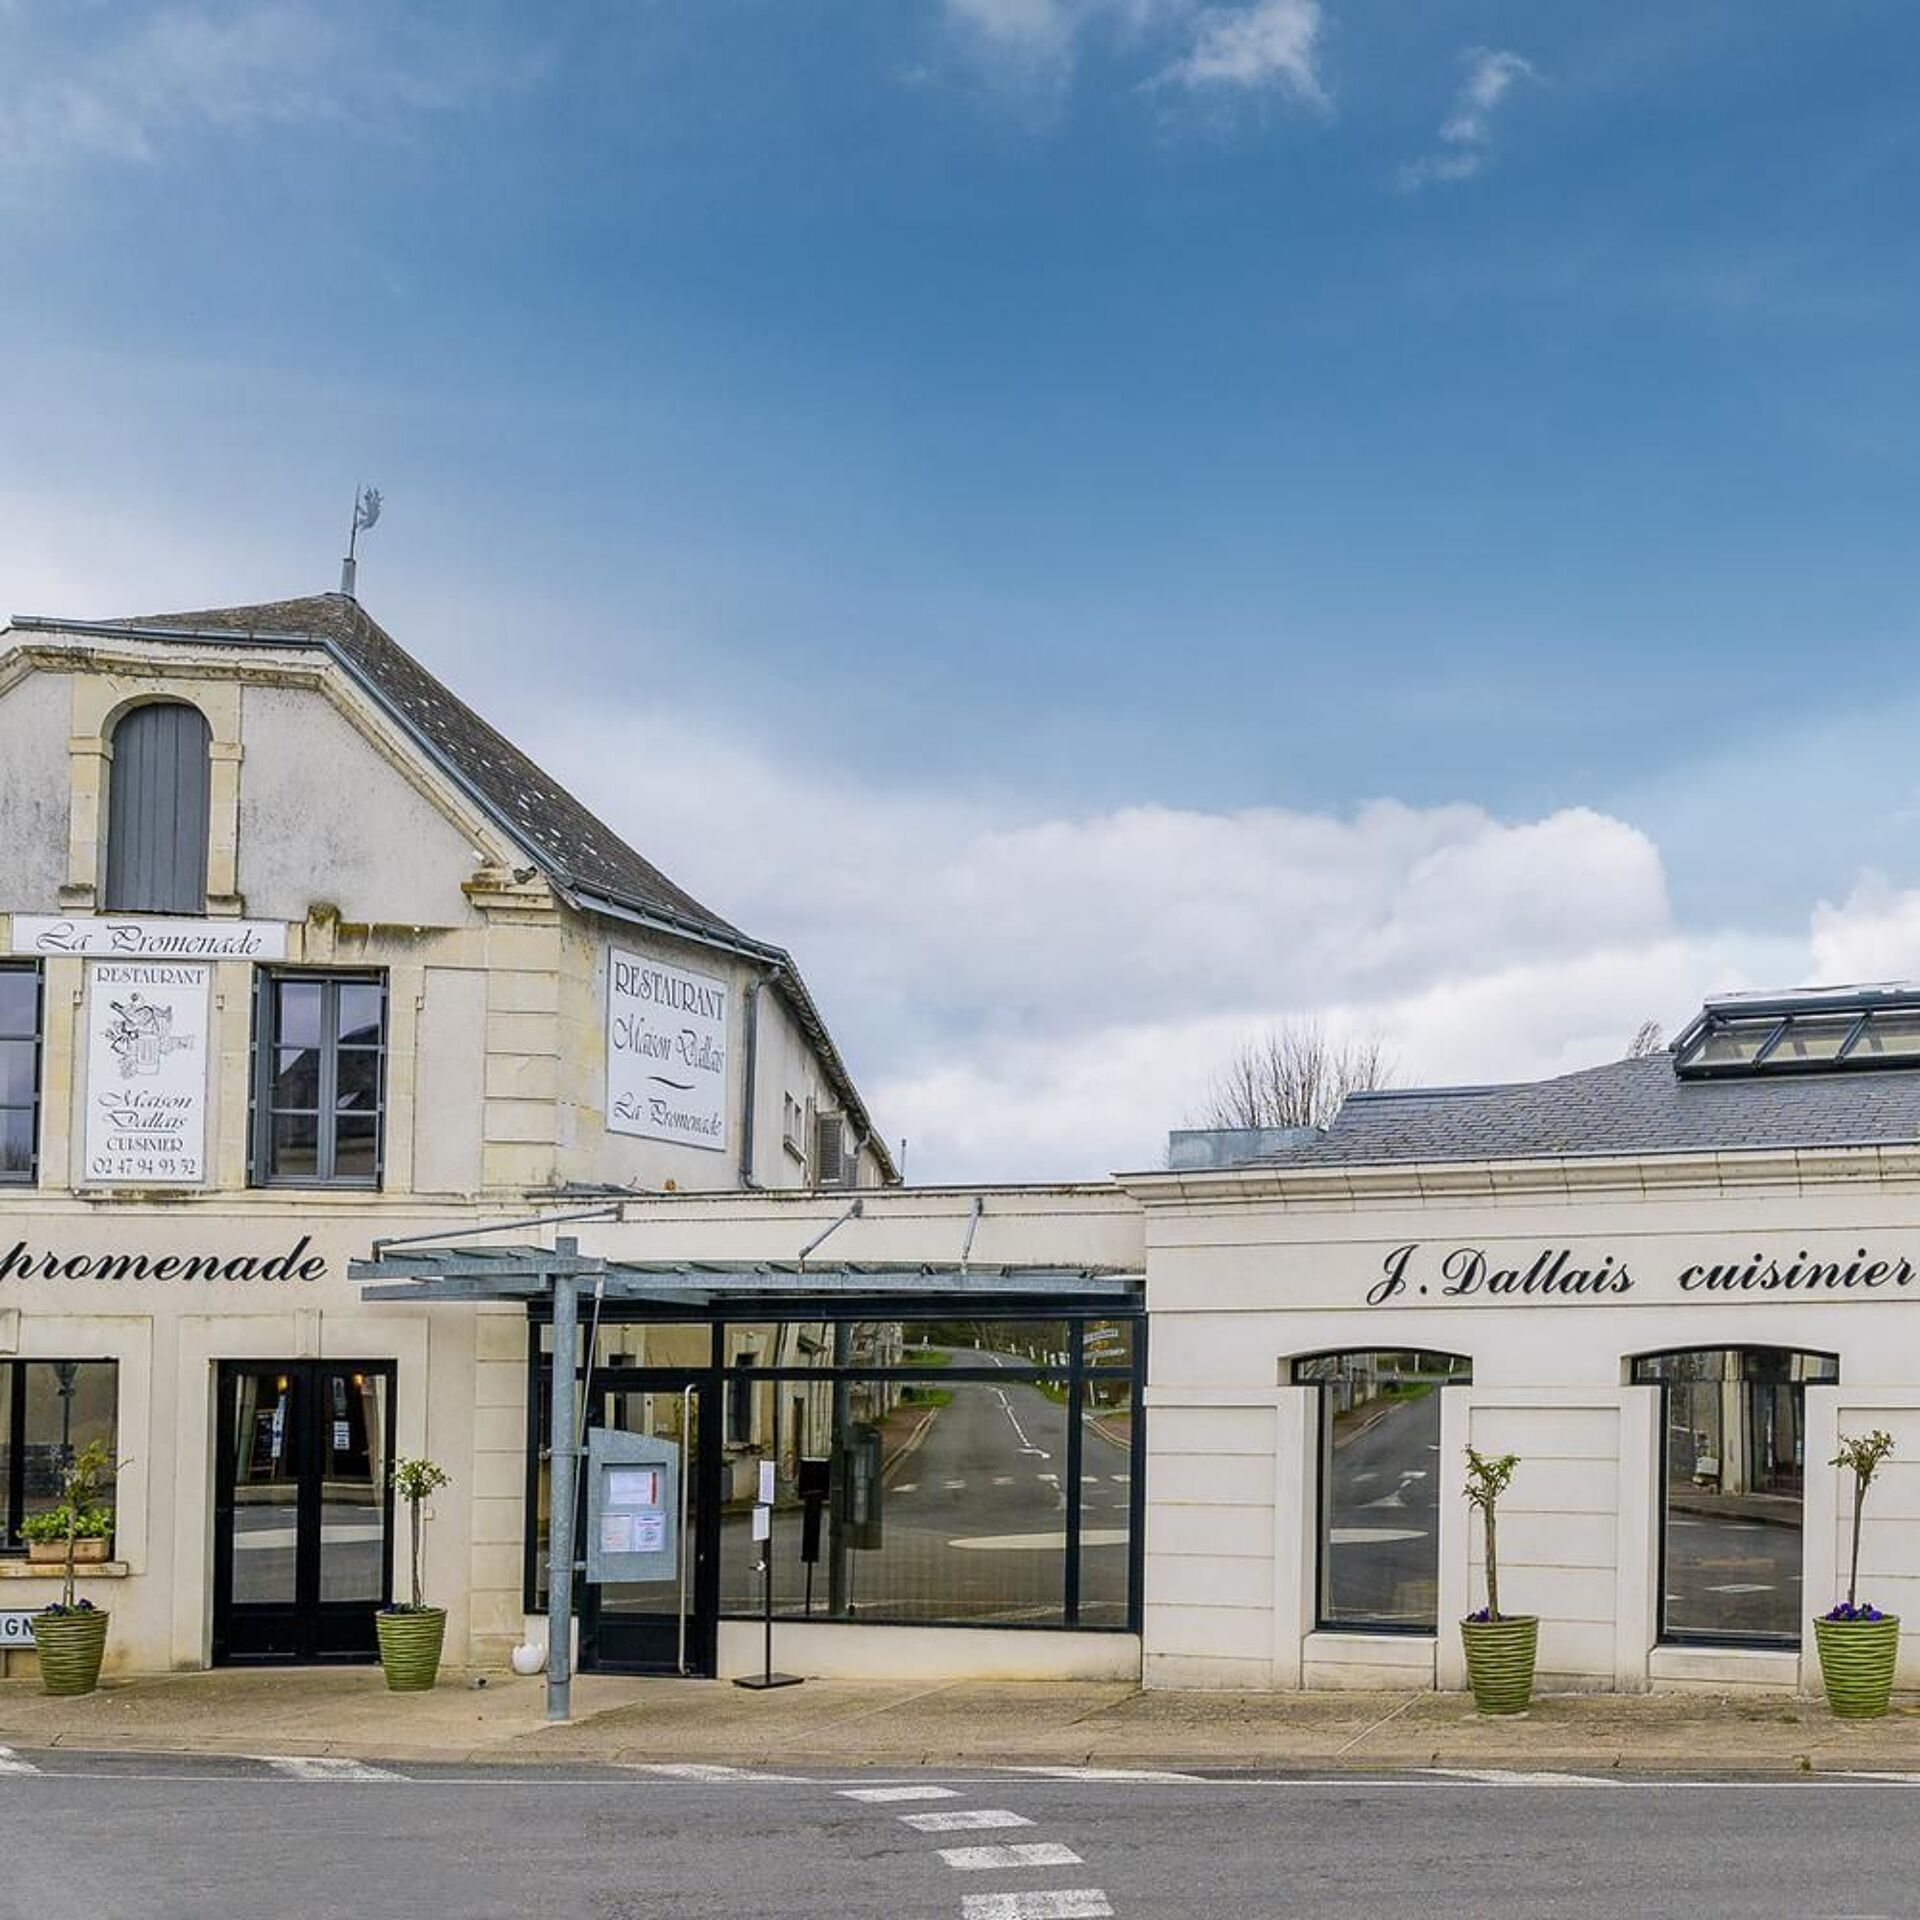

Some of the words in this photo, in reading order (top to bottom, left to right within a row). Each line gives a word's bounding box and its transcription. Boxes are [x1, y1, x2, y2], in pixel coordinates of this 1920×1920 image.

[36, 922, 92, 951] La
[107, 925, 262, 955] Promenade
[96, 967, 205, 984] RESTAURANT
[615, 962, 724, 1021] RESTAURANT
[612, 1013, 672, 1061] Maison
[98, 1090, 193, 1108] Maison
[614, 1091, 642, 1121] La
[648, 1097, 722, 1137] Promenade
[107, 1138, 184, 1152] CUISINIER
[93, 1157, 112, 1174] 02
[117, 1158, 133, 1174] 47
[138, 1158, 154, 1174] 94
[159, 1158, 176, 1174] 93
[0, 1236, 328, 1281] promenade
[1679, 1248, 1917, 1292] cuisinier
